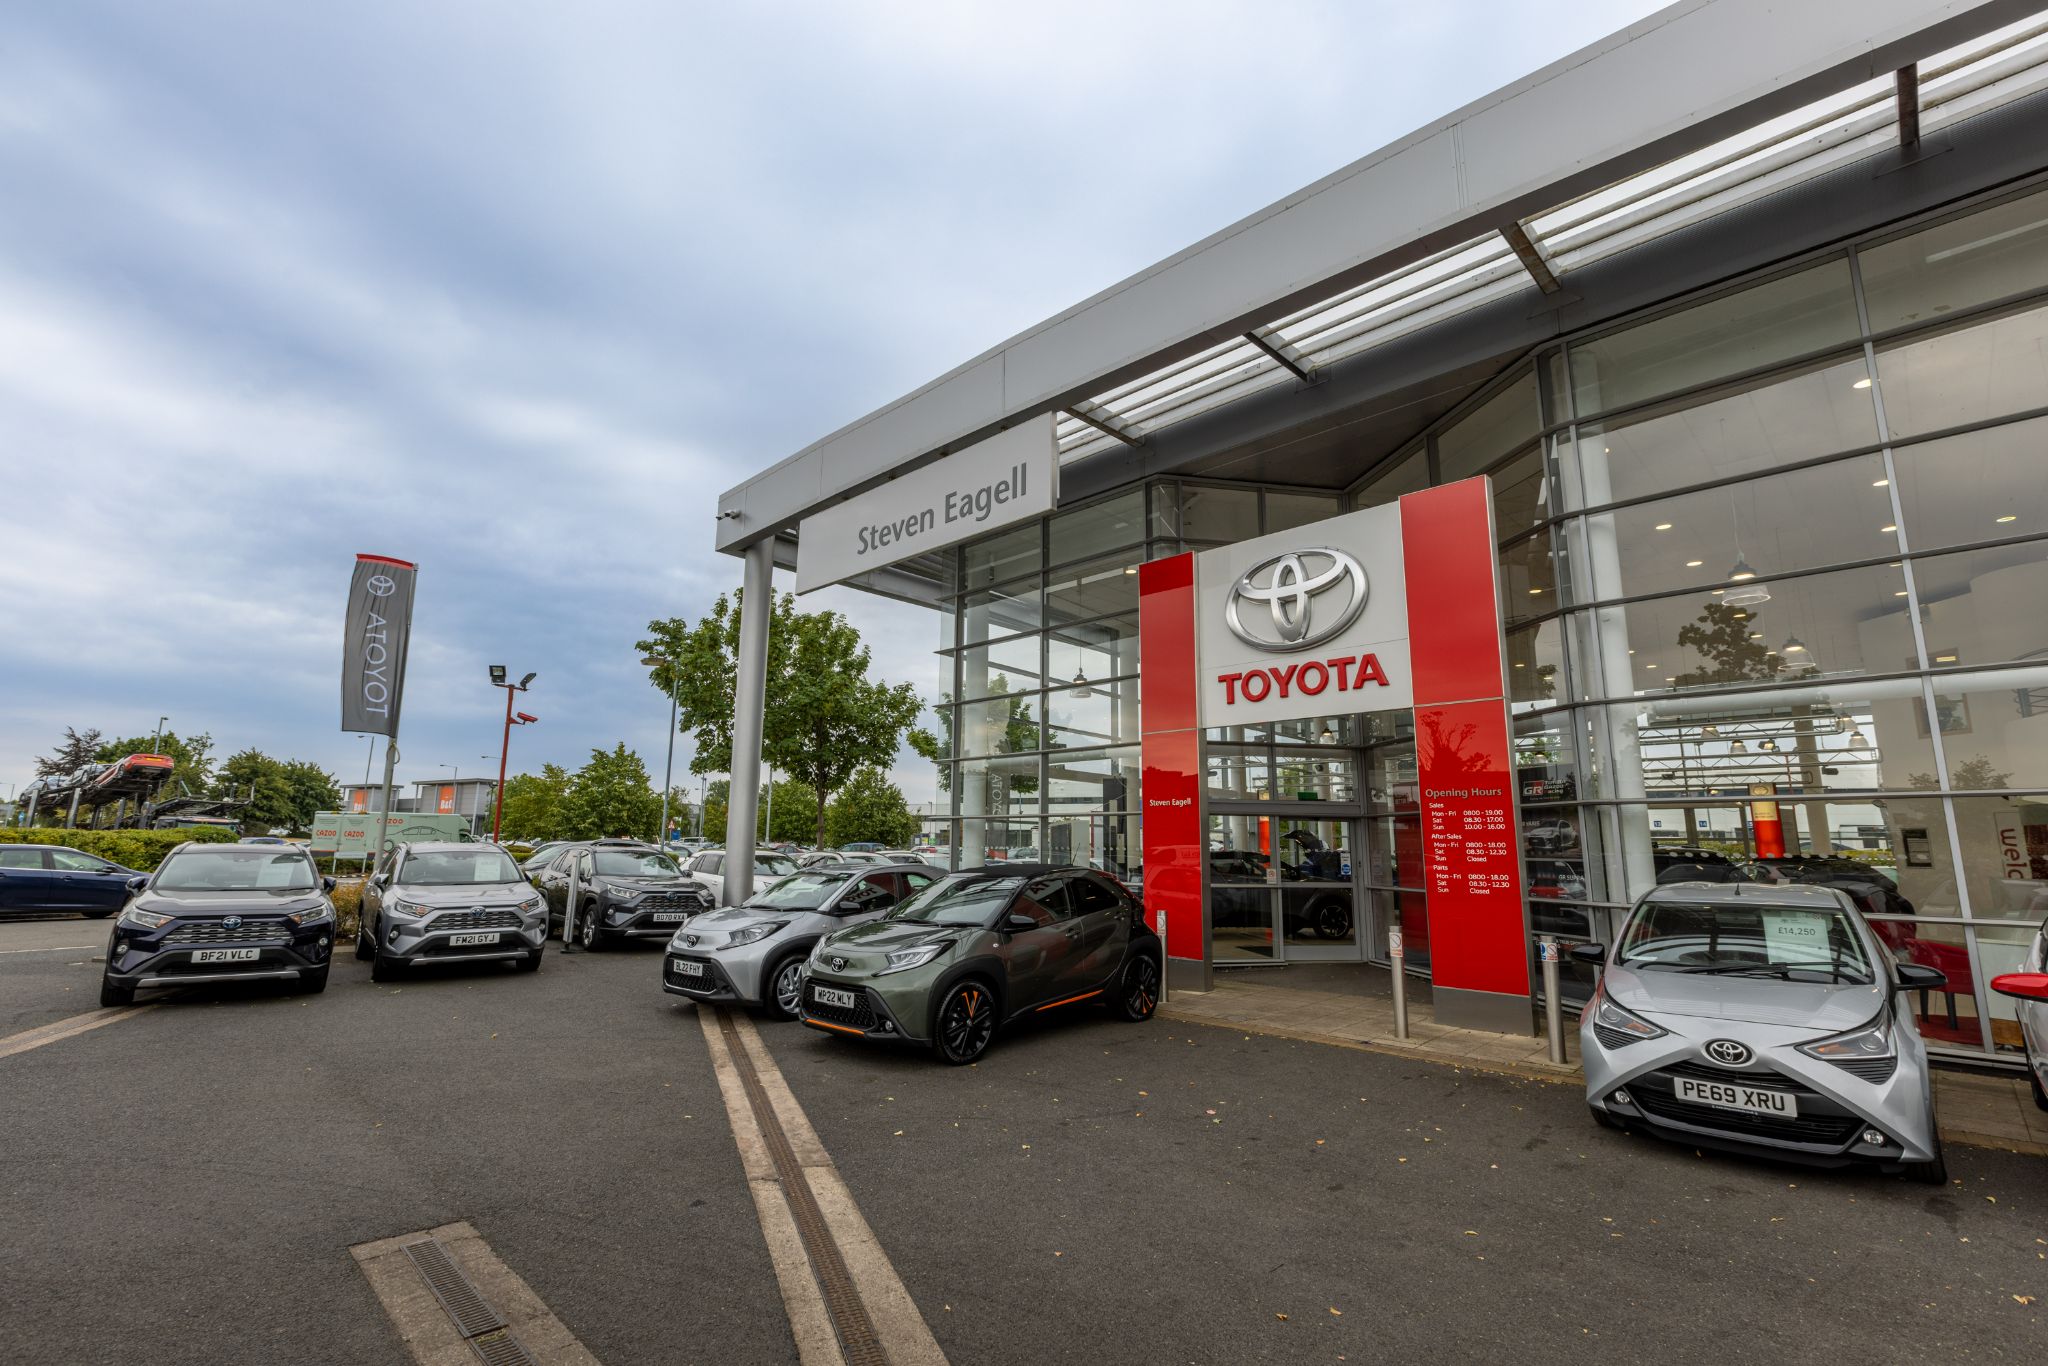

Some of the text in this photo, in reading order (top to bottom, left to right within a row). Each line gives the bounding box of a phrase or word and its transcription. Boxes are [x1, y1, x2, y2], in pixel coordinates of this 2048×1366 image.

[857, 462, 1027, 555] Steven Eagell
[1217, 653, 1390, 705] TOYOTA
[1425, 788, 1502, 799] Opening Hours
[1172, 797, 1192, 807] Eagell
[1778, 926, 1816, 936] £14,250
[455, 934, 495, 944] FM21 GYJ
[200, 950, 253, 961] BF21 VLC
[689, 964, 701, 974] FHY
[1683, 1080, 1737, 1104] PE69
[1742, 1089, 1785, 1112] XRU
